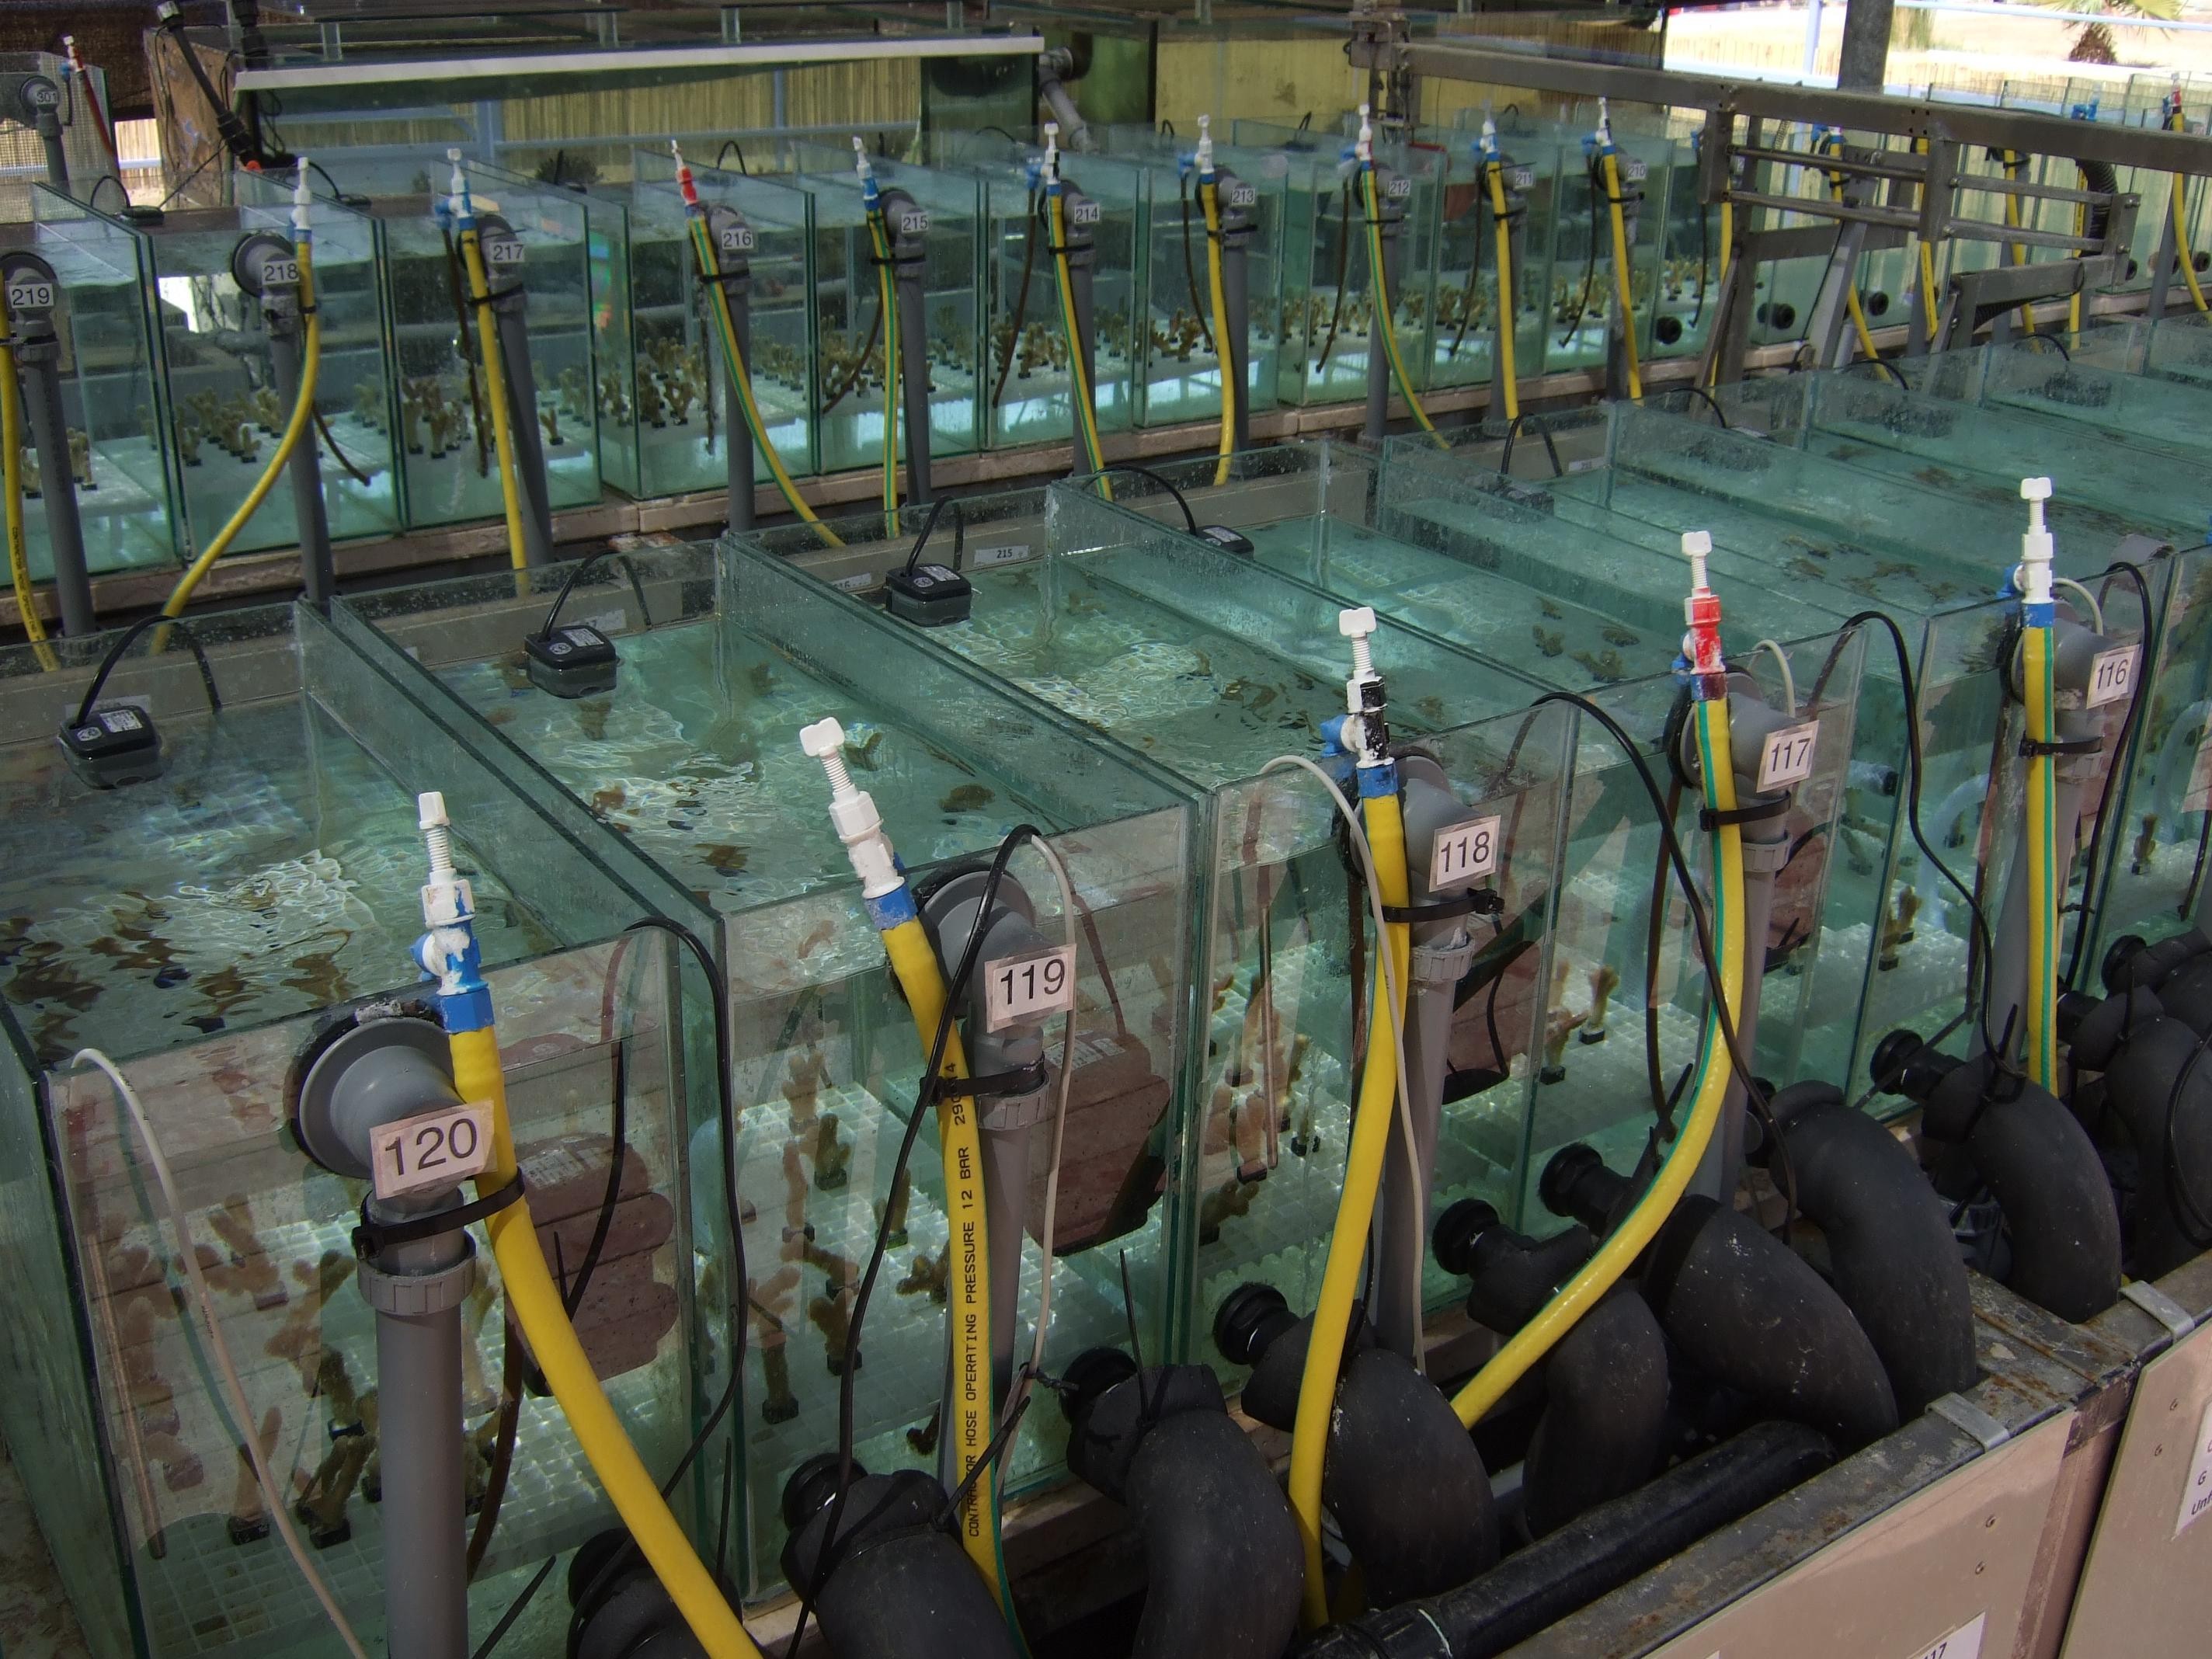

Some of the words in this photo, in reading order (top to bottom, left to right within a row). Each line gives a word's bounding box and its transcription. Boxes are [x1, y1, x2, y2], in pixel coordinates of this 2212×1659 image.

[1232, 190, 1254, 203] 213
[1389, 182, 1409, 194] 212
[903, 215, 927, 231] 215
[1076, 207, 1098, 222] 214
[723, 231, 751, 247] 216
[494, 244, 523, 260] 217
[264, 263, 299, 281] 218
[12, 287, 50, 305] 219
[996, 548, 1013, 558] 215
[2098, 659, 2128, 690] 116
[1772, 737, 1810, 772] 117
[1441, 831, 1490, 873] 118
[1000, 958, 1065, 1005] 119
[384, 1118, 477, 1176] 120
[958, 1146, 971, 1180] BAR
[961, 1189, 973, 1209] 12
[963, 1221, 977, 1304] PRESSURE
[965, 1313, 977, 1401] OPERATING
[965, 1410, 977, 1447] HOSE
